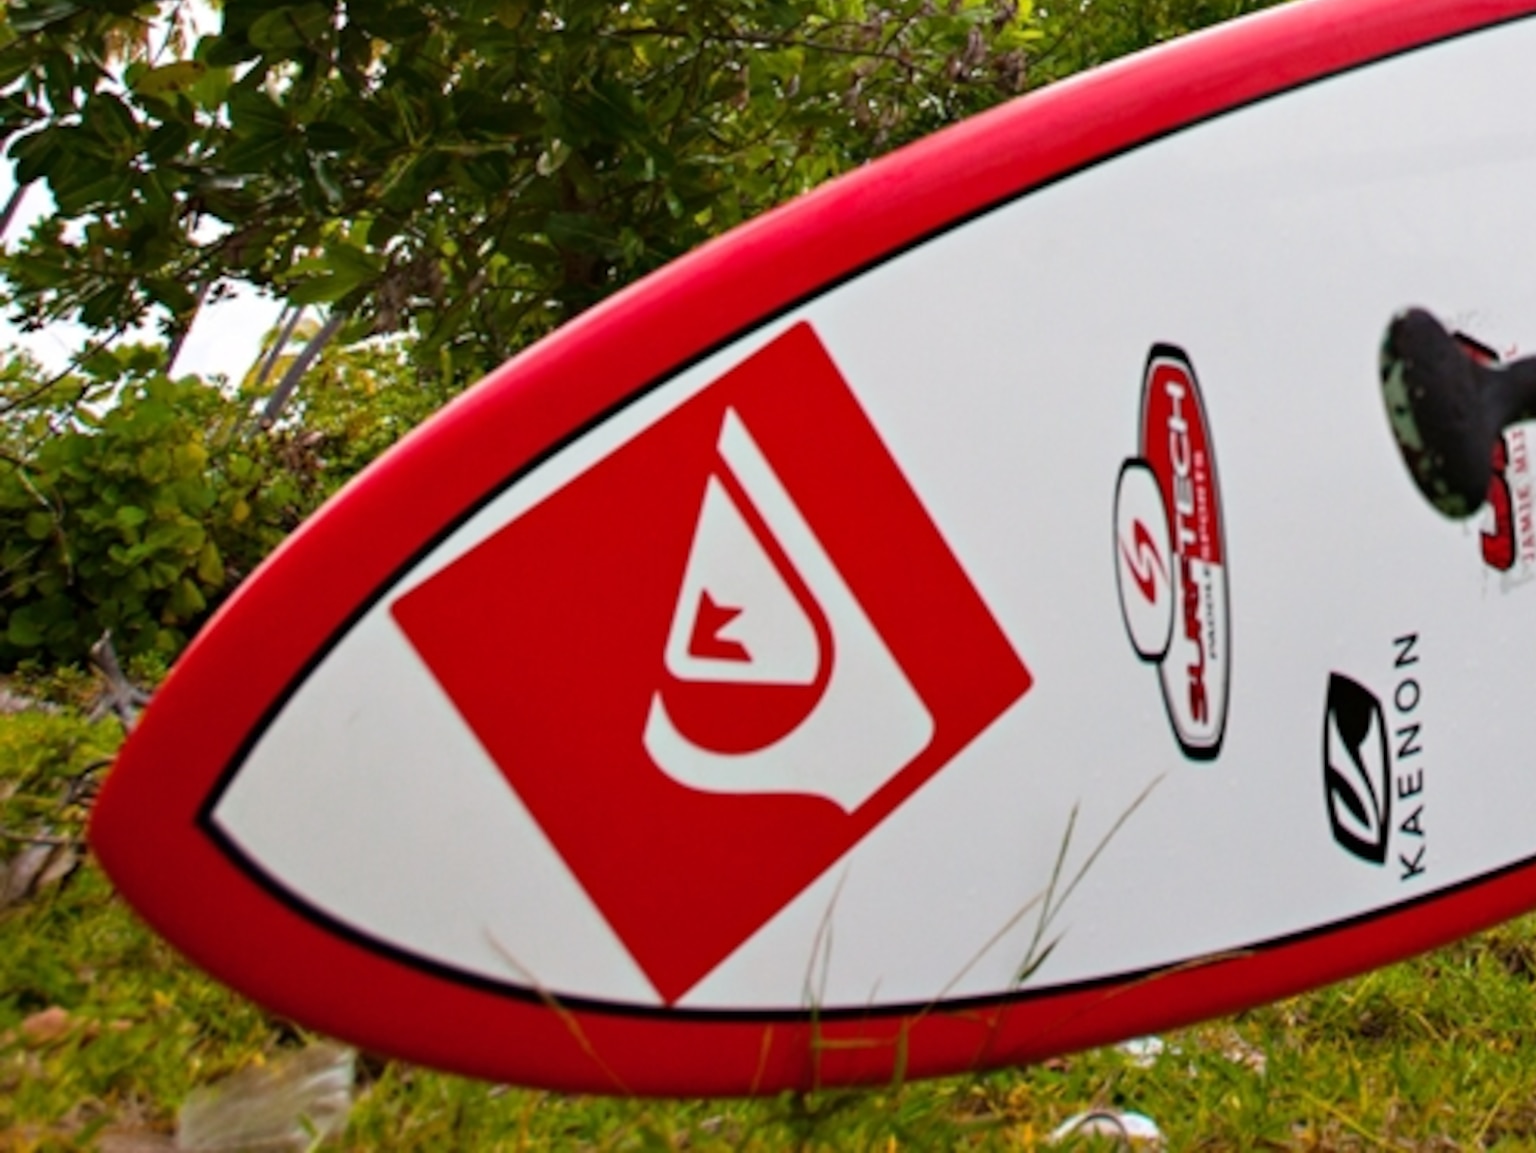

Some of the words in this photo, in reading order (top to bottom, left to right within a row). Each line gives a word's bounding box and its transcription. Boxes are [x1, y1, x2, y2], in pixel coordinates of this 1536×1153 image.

[1166, 381, 1209, 726] SURFTECH
[1192, 450, 1211, 560] SPORTS
[1515, 484, 1536, 565] JAMIE
[1392, 631, 1426, 882] KAENON
